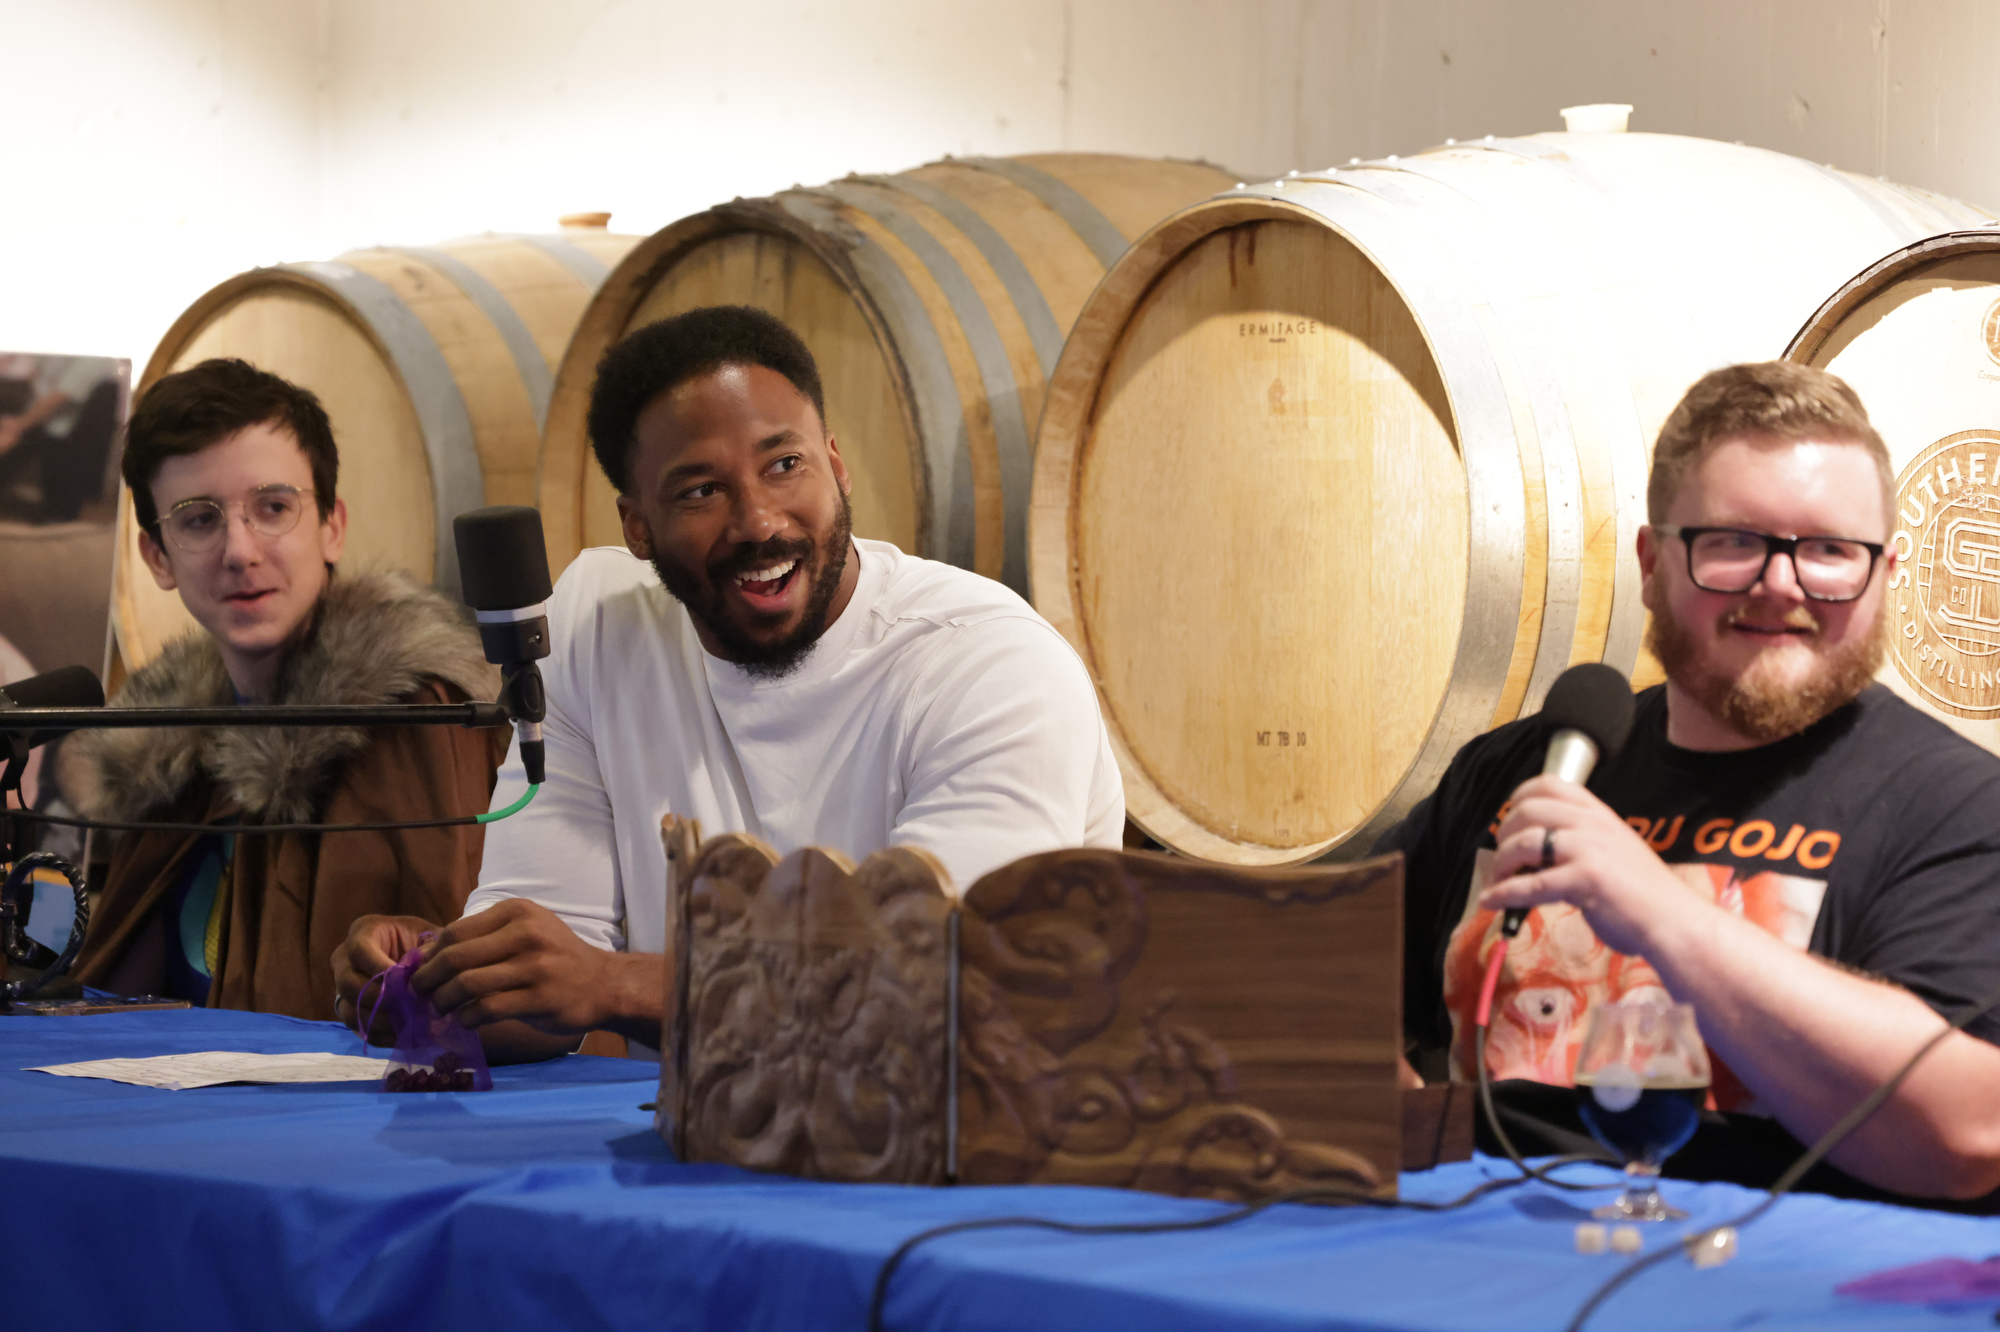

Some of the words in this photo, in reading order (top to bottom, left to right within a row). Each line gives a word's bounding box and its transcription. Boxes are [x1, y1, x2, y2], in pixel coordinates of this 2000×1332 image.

[1239, 321, 1316, 337] ERMITAGE
[1952, 585, 1967, 605] CO
[1693, 818, 1842, 870] GOJO
